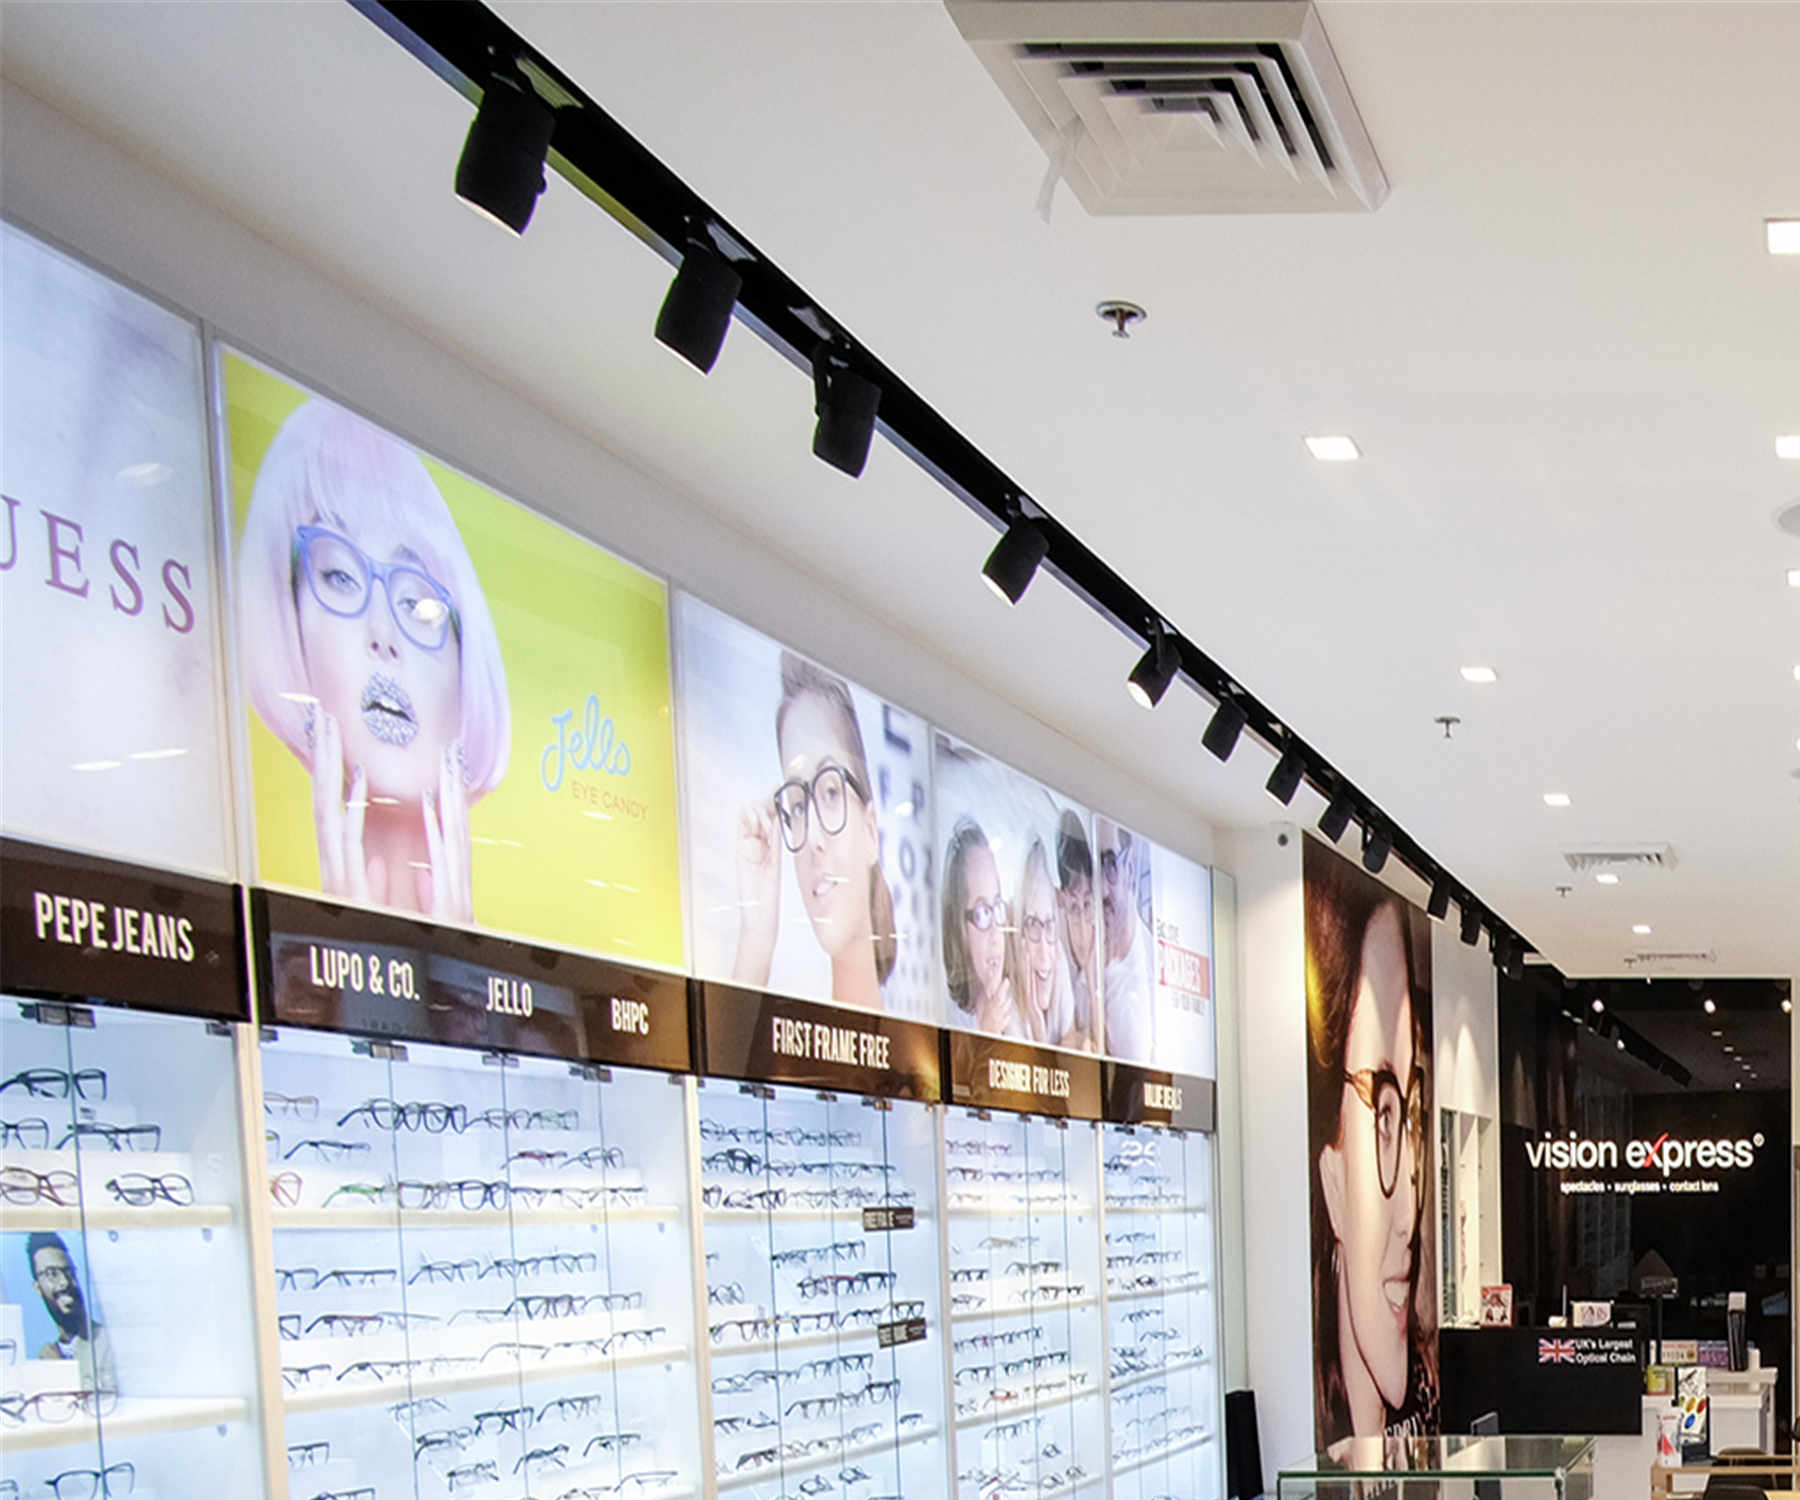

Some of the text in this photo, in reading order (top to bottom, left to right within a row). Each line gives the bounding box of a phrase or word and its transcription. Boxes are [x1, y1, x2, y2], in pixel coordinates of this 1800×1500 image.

[571, 780, 649, 820] EYE CANDY
[33, 891, 195, 963] PEPE JEANS
[309, 945, 421, 1001] LUPO & CO.
[486, 976, 534, 1018] JELLO
[611, 997, 650, 1036] BHPC
[772, 1015, 890, 1070] FIRST FRAME FREE
[988, 1058, 1071, 1098] DESIGNER FOR LESS
[1525, 1131, 1754, 1177] vision express
[1560, 1180, 1719, 1195] spectacles sunglasses contact lens
[1576, 1352, 1636, 1366] Optical Chain
[1598, 1338, 1633, 1351] Largest
